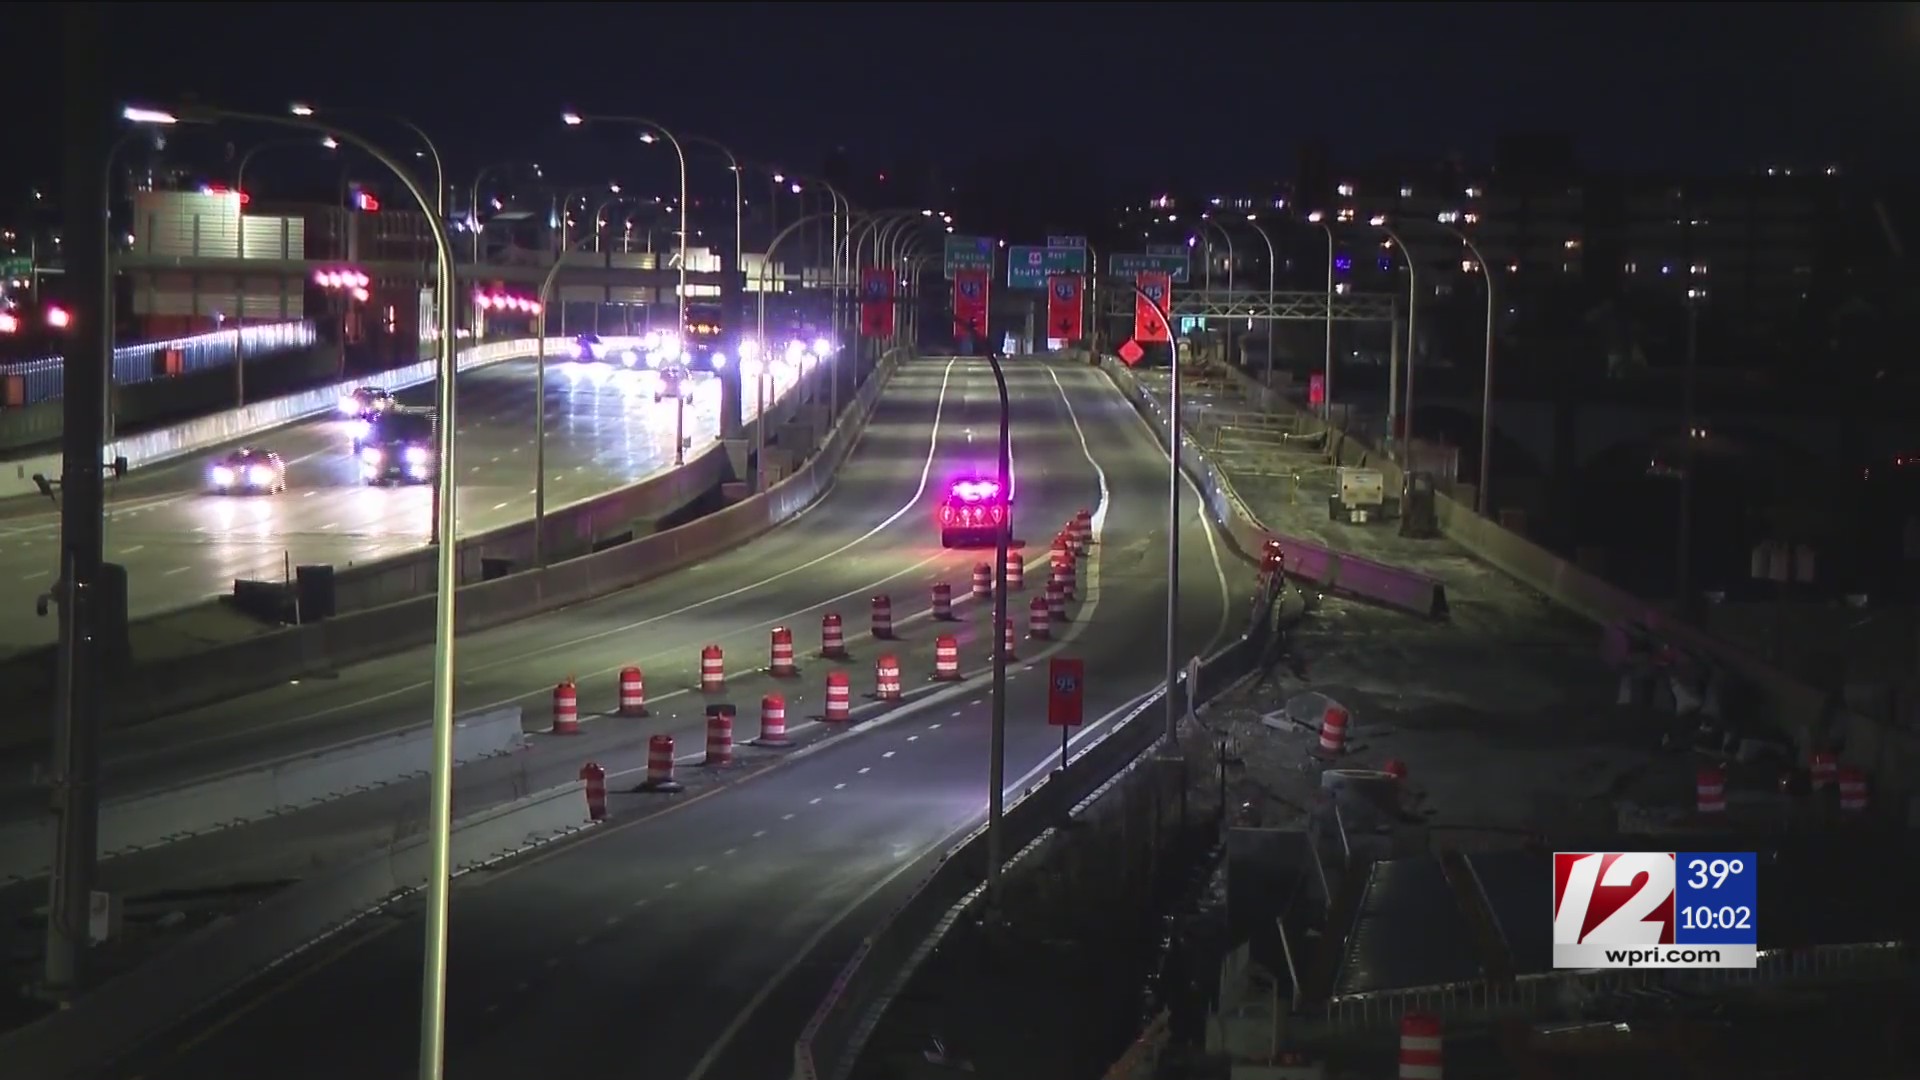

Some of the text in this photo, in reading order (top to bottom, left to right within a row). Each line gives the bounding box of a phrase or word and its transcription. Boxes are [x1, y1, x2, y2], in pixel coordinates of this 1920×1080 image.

[962, 282, 980, 296] 95
[1057, 284, 1074, 298] 95
[1144, 285, 1162, 300] 95
[1056, 678, 1075, 692] 95
